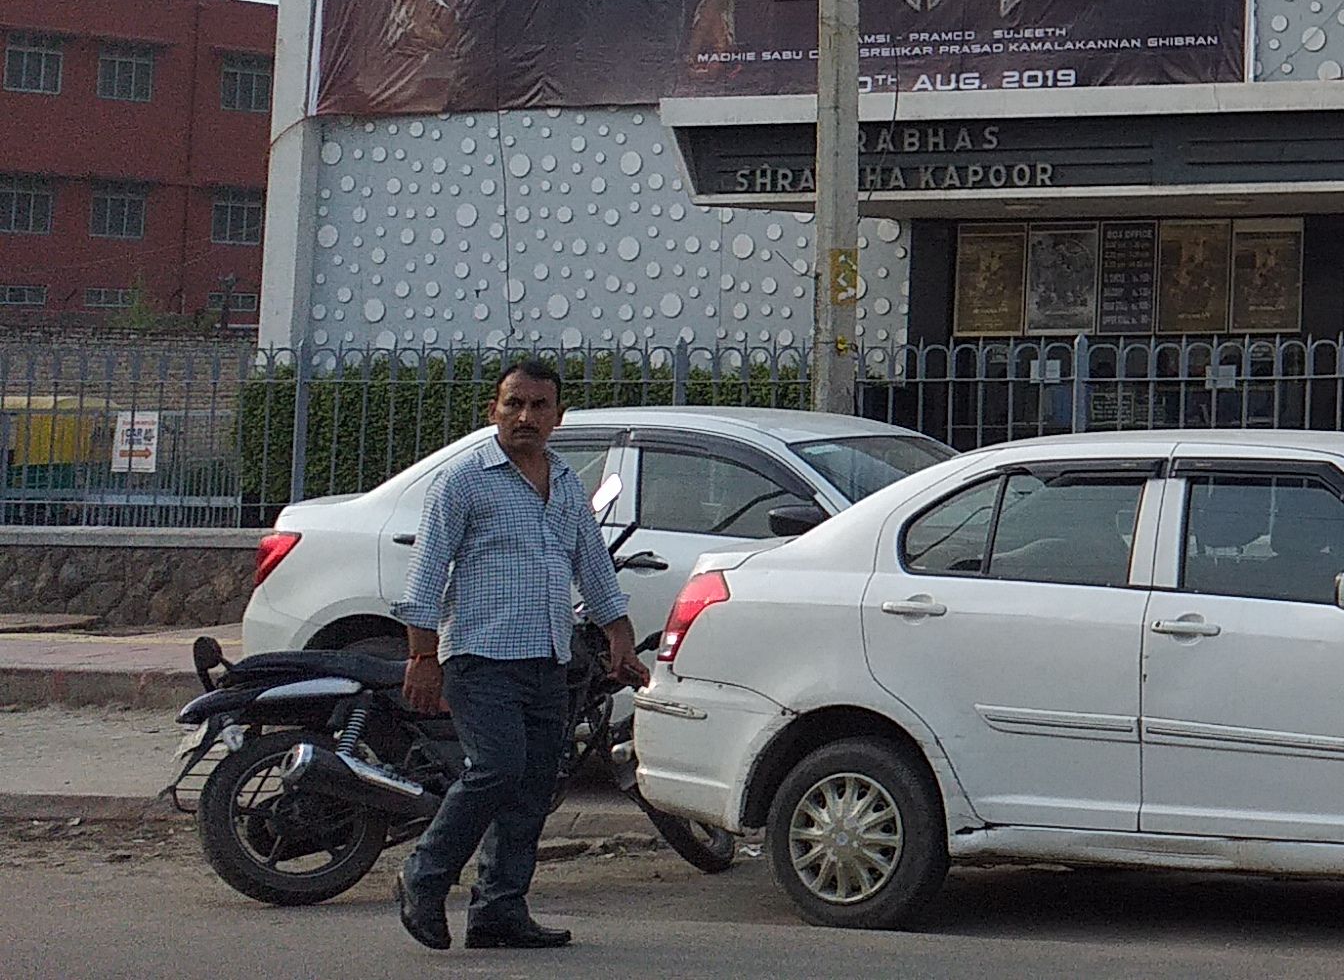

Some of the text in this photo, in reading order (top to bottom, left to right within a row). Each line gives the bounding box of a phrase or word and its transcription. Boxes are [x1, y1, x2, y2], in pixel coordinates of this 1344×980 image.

[992, 26, 1067, 40] SUJEETH
[697, 51, 756, 62] MADHIE
[761, 50, 803, 60] SABU
[939, 42, 1004, 55] PRASAD
[1008, 37, 1142, 52] KAMALAKANNAN
[1146, 35, 1219, 47] GHIBRAN
[912, 72, 988, 91] AUG.
[1002, 70, 1077, 87] 2019
[859, 126, 1001, 152] RABHAS
[735, 163, 1055, 193] SHRAHA KAPOOR
